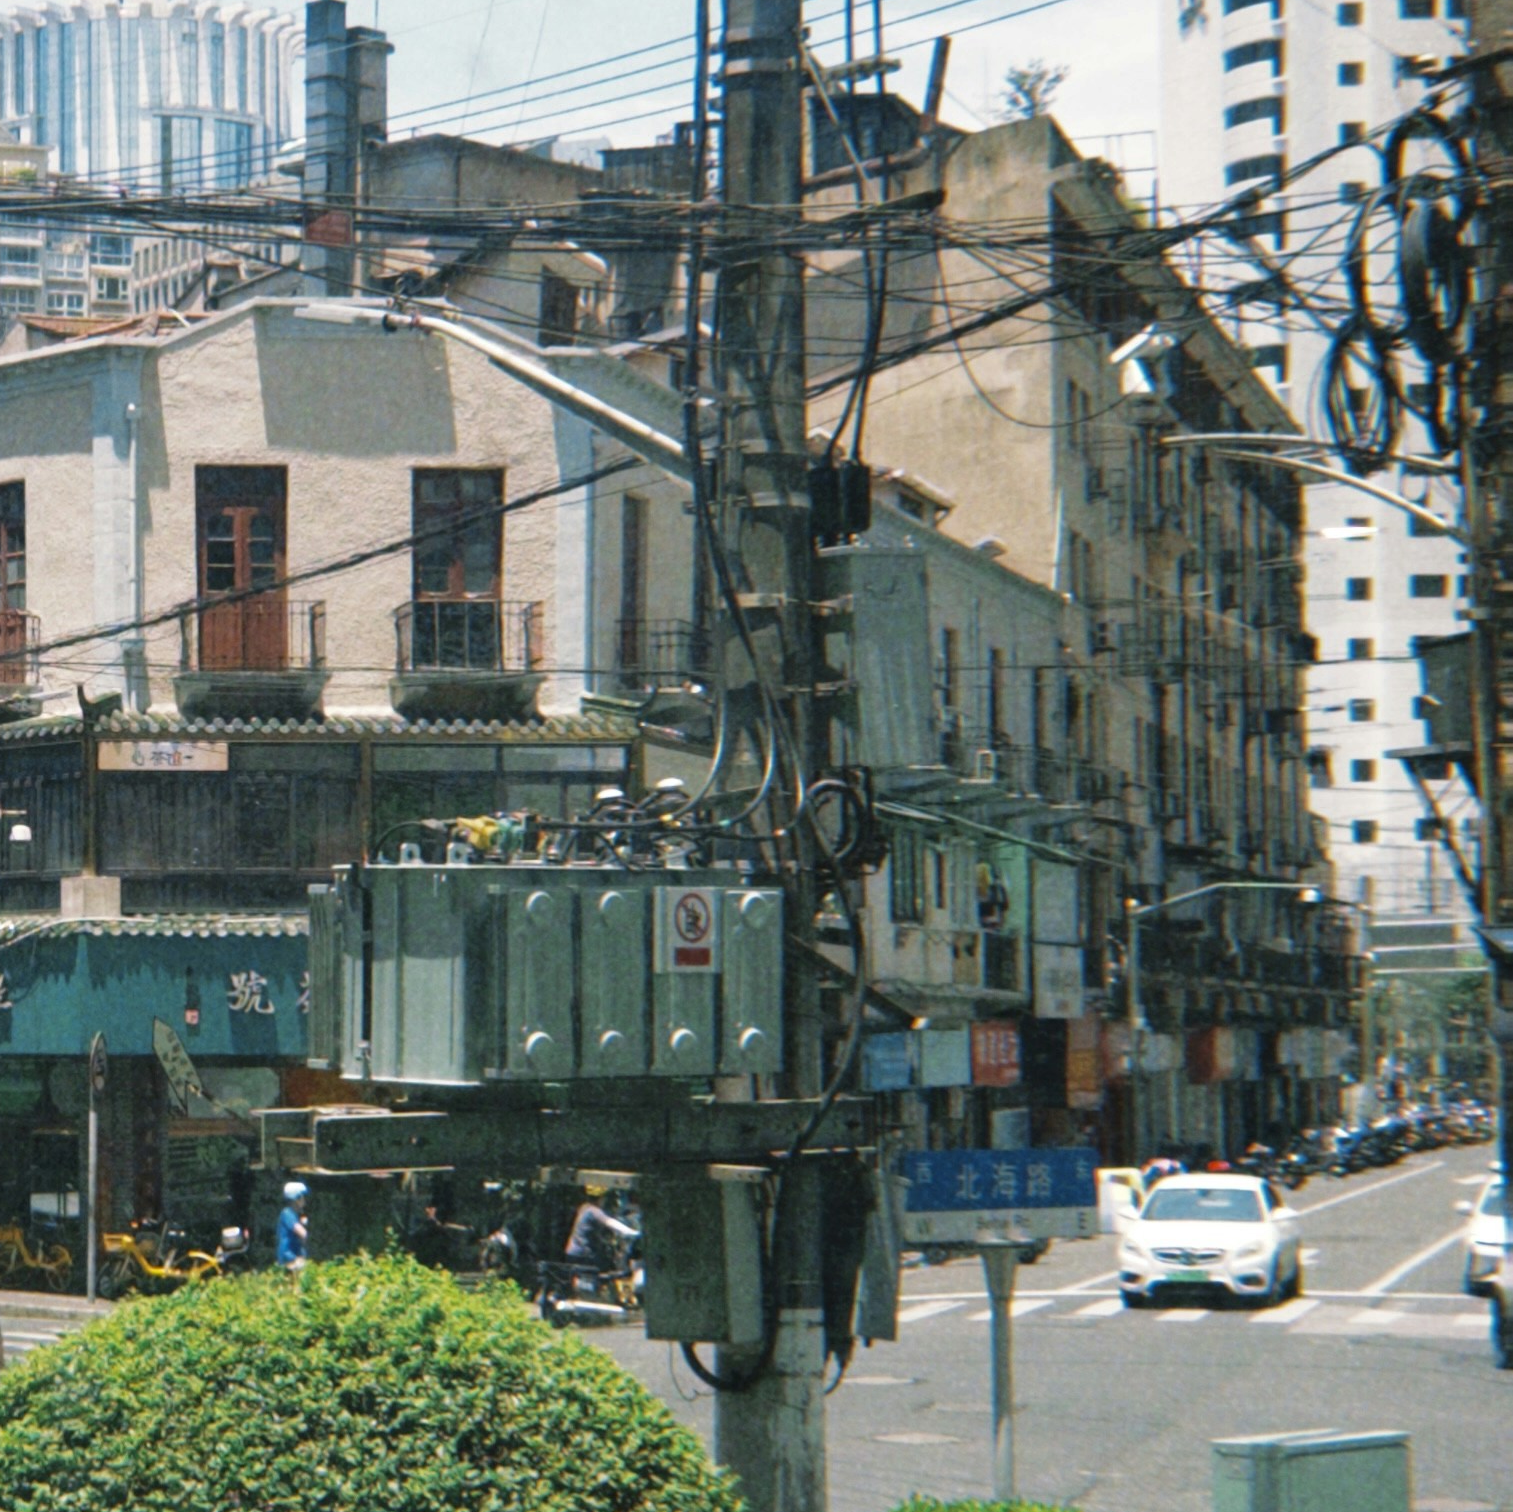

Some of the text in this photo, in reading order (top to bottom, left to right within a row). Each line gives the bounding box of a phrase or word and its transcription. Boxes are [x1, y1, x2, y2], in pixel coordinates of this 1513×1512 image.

[916, 1161, 933, 1184] 西
[955, 1161, 1053, 1201] 北海路
[1077, 1211, 1088, 1230] E
